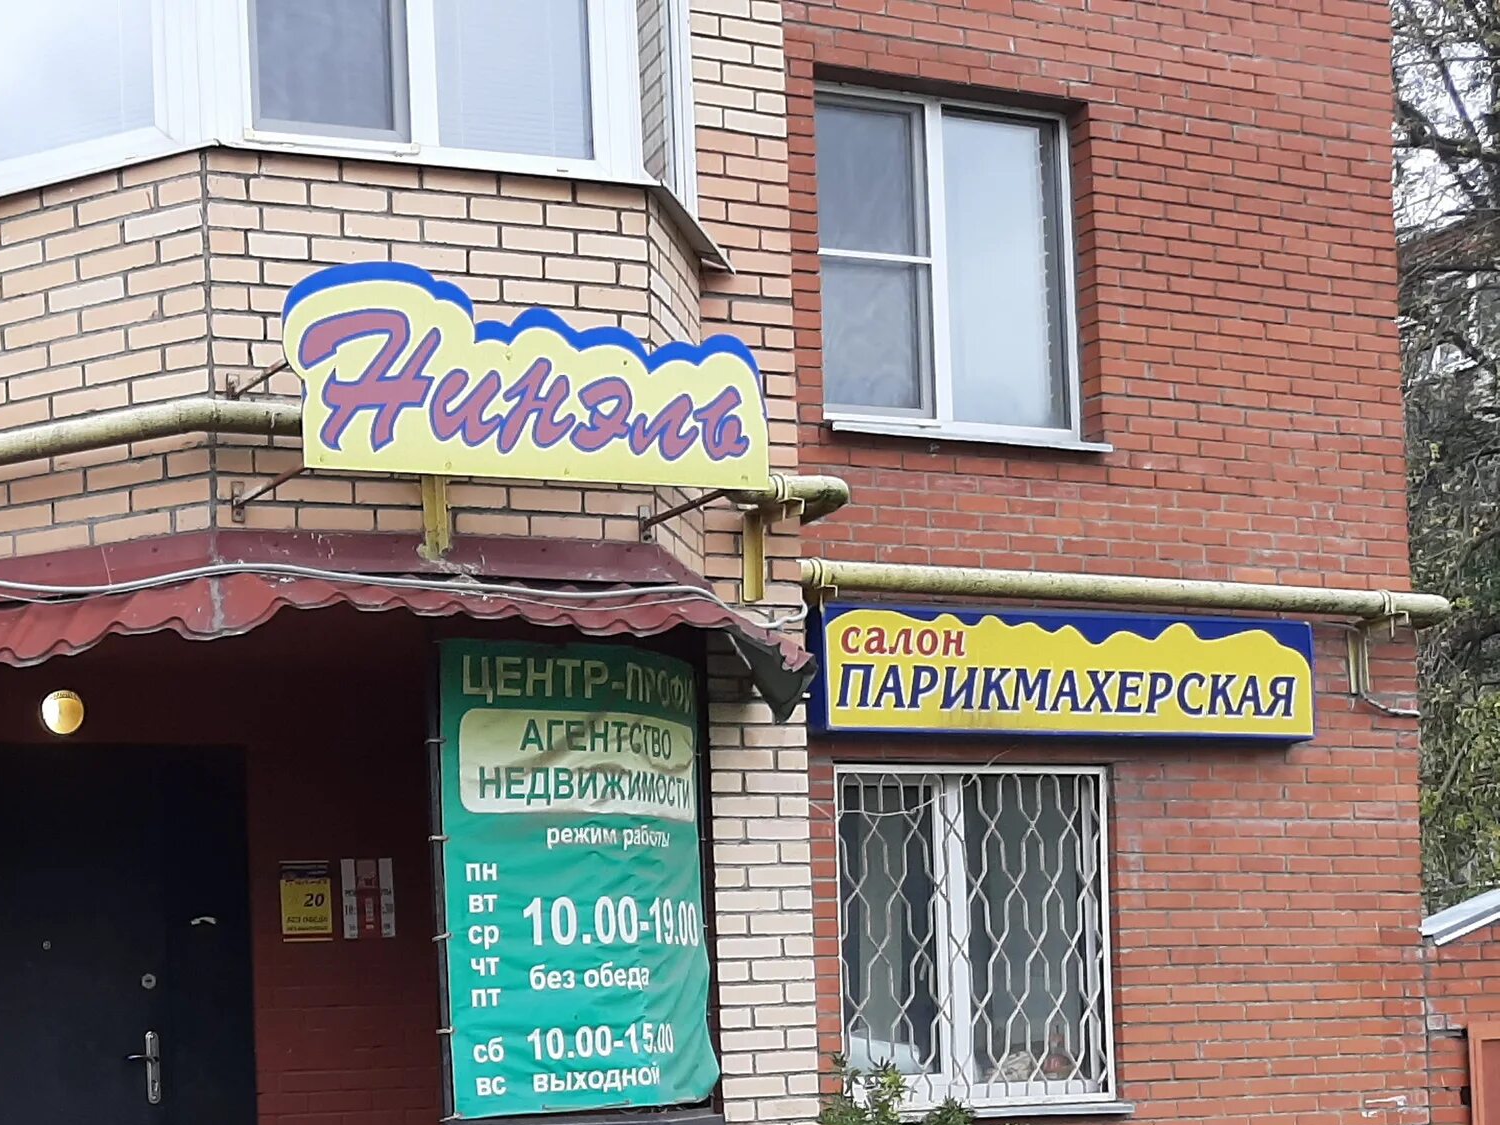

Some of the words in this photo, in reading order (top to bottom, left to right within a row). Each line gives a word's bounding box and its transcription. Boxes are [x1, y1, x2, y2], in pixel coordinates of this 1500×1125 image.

[299, 307, 750, 461] Нинэль
[840, 624, 966, 657] салон
[835, 663, 1296, 718] ПАРИКМАХЕРСКАЯ
[519, 718, 672, 760] АГЕНТСТВО
[478, 765, 691, 809] НЕДВИЖИМОСТИ
[546, 826, 617, 850] режим
[622, 824, 670, 850] работы
[465, 862, 498, 882] пн
[303, 893, 325, 908] 20
[468, 894, 498, 914] вт
[522, 895, 700, 947] 10.00-19.00
[467, 926, 500, 949] ср
[470, 957, 500, 977] чт
[529, 964, 576, 991] без
[583, 961, 650, 990] обеда
[471, 988, 501, 1008] пт
[472, 1036, 505, 1064] сб
[527, 1022, 675, 1062] 10.00-15.00
[475, 1075, 507, 1097] вс
[533, 1061, 660, 1093] выходной
